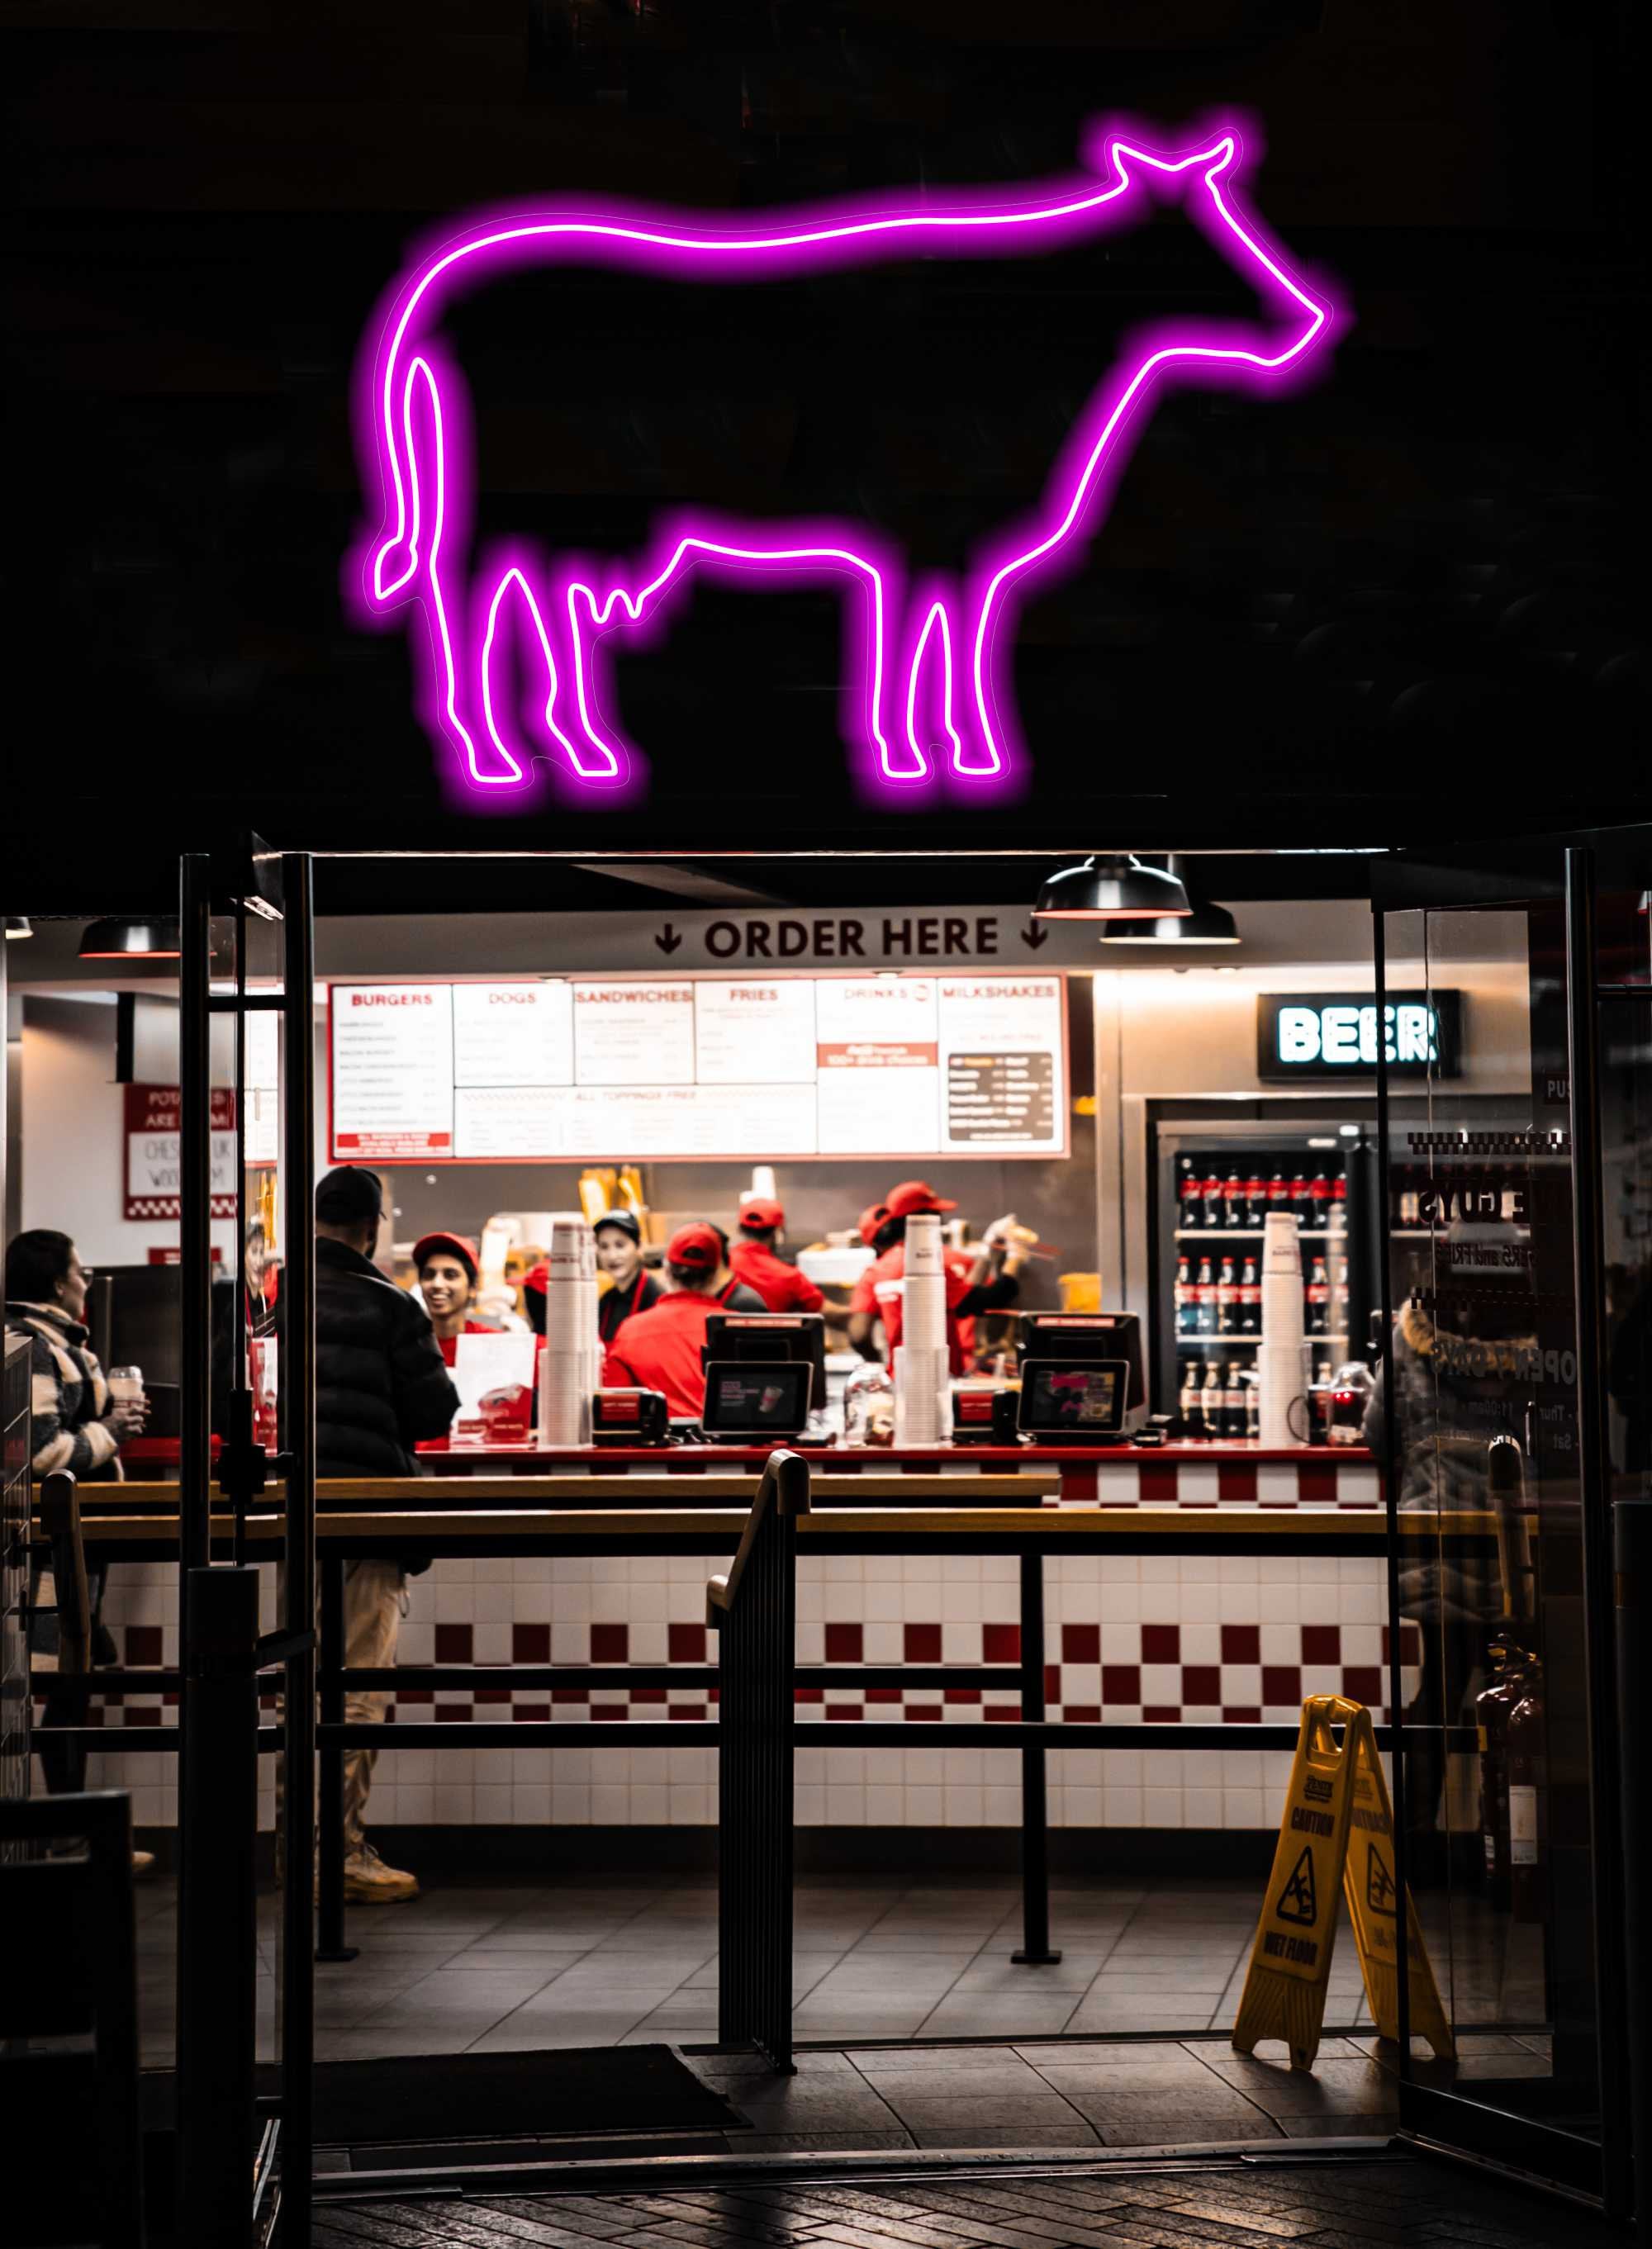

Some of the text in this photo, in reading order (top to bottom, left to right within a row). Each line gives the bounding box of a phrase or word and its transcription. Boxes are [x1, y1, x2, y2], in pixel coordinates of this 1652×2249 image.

[705, 918, 999, 958] ORDER HERE
[488, 991, 538, 1004] DOGS
[575, 989, 692, 1004] SANDWICHES
[729, 988, 779, 1002] FRIES
[843, 987, 909, 1000] DRINKS
[942, 985, 1056, 998] MILKSHAKES
[350, 993, 434, 1007] BURGERS
[1277, 1006, 1437, 1064] BEER
[1547, 1079, 1569, 1098] PU
[1291, 1806, 1336, 1838] CAUTION
[1265, 1931, 1319, 1967] WET FLOOR
